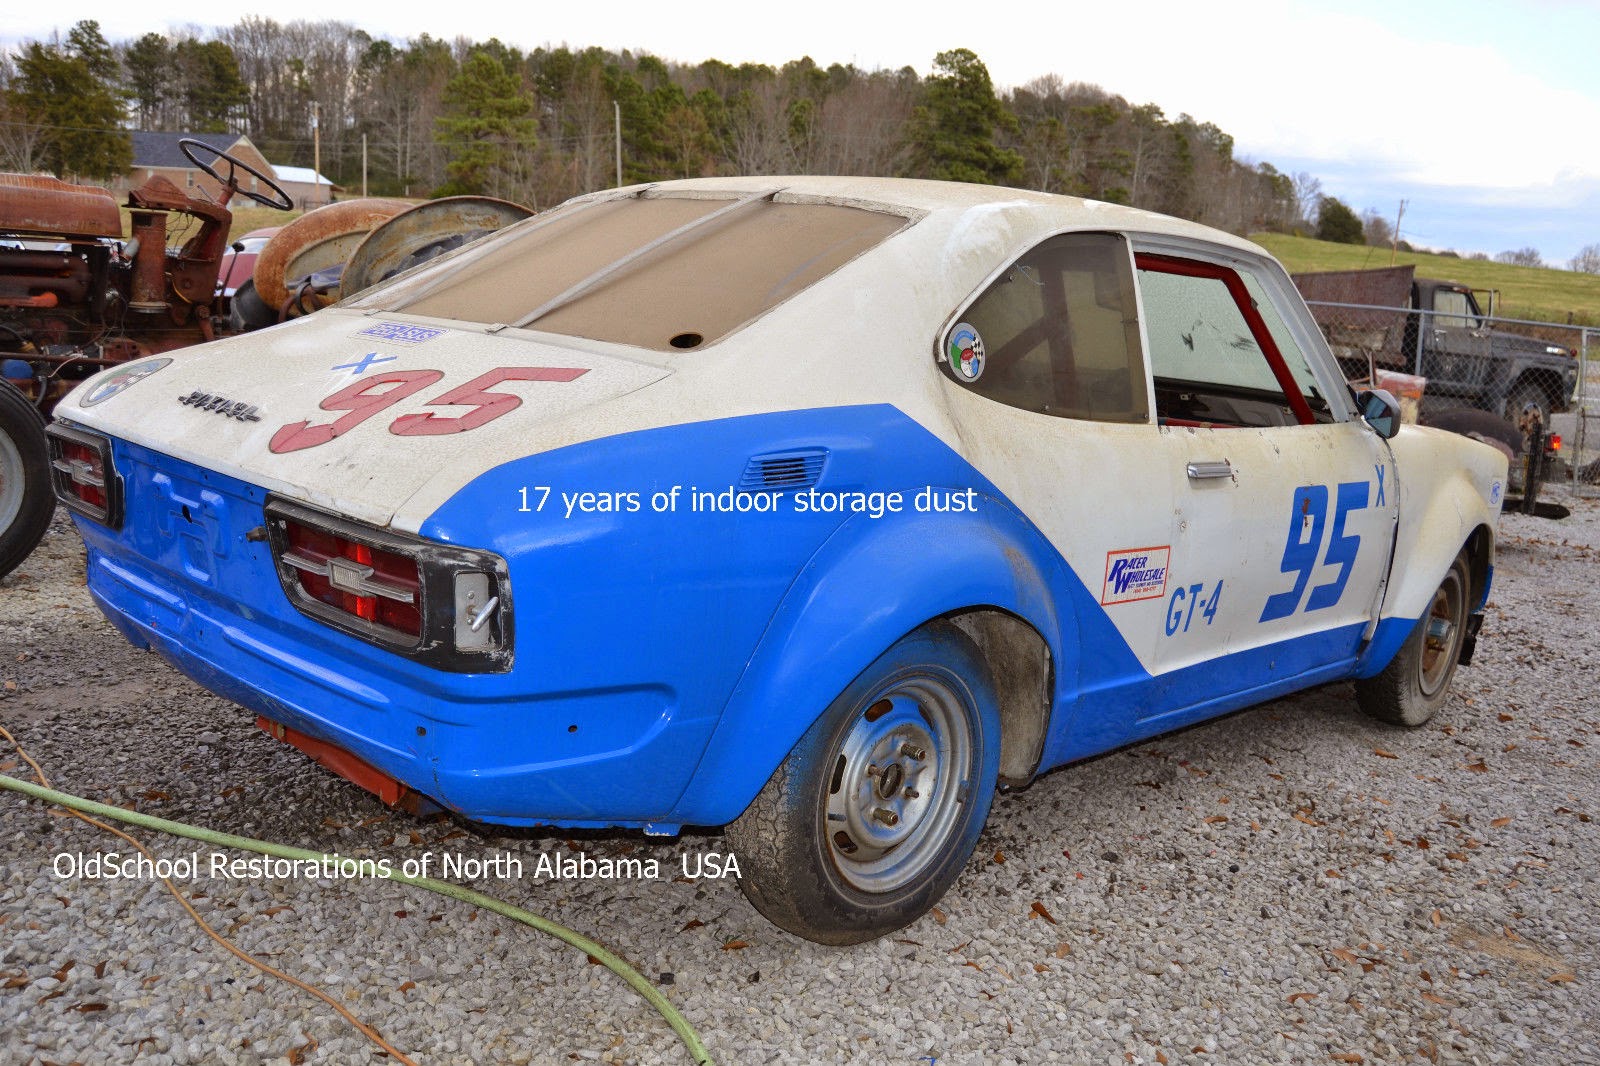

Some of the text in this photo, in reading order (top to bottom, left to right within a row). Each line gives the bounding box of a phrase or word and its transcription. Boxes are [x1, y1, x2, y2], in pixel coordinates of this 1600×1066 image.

[269, 366, 592, 454] 95
[1108, 556, 1148, 582] RACER
[1258, 481, 1370, 623] 95
[1114, 568, 1166, 595] WHOLESALE
[1165, 579, 1224, 637] GT-4
